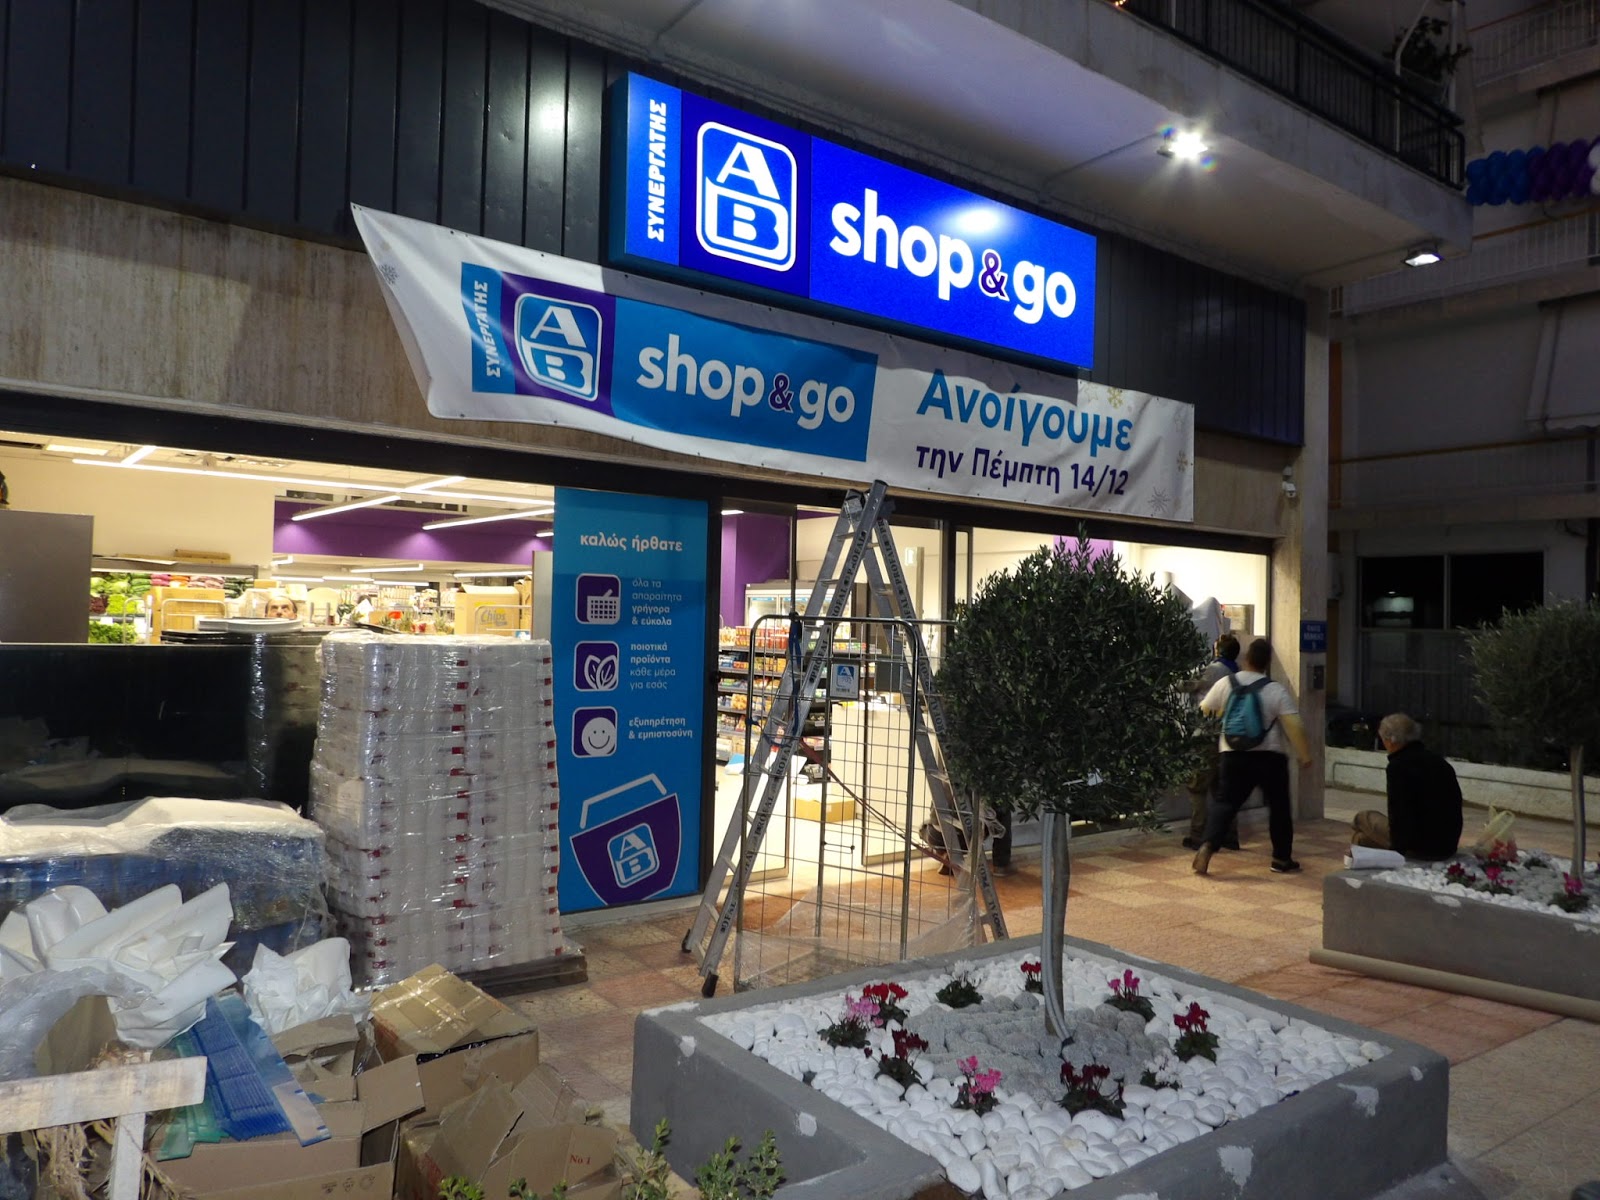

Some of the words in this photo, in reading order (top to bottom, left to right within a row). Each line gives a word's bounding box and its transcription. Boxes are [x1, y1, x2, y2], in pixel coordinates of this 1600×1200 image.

[648, 99, 666, 242] ΣΥΝΕΡΓΑΤΗΣ
[474, 280, 501, 378] ΣΥΝΕΡΓΑΤΗΣ
[916, 368, 1133, 457] Ανοίγουμε
[916, 445, 963, 479] την
[972, 447, 1060, 493] Πέμπτη
[1070, 463, 1129, 497] 14/12
[580, 532, 627, 550] καλώς
[632, 535, 683, 552] ήρθατε
[632, 604, 670, 615] γρήγορα
[641, 616, 672, 626] εύκολα
[630, 641, 668, 650] ποιοτικά
[630, 654, 670, 665] προϊόντα
[630, 666, 651, 676] κάθε
[654, 668, 676, 678] μέρα
[630, 682, 643, 690] για
[628, 716, 686, 728] εξυπηρέτηση
[638, 728, 693, 740] εμπιστοσύνη
